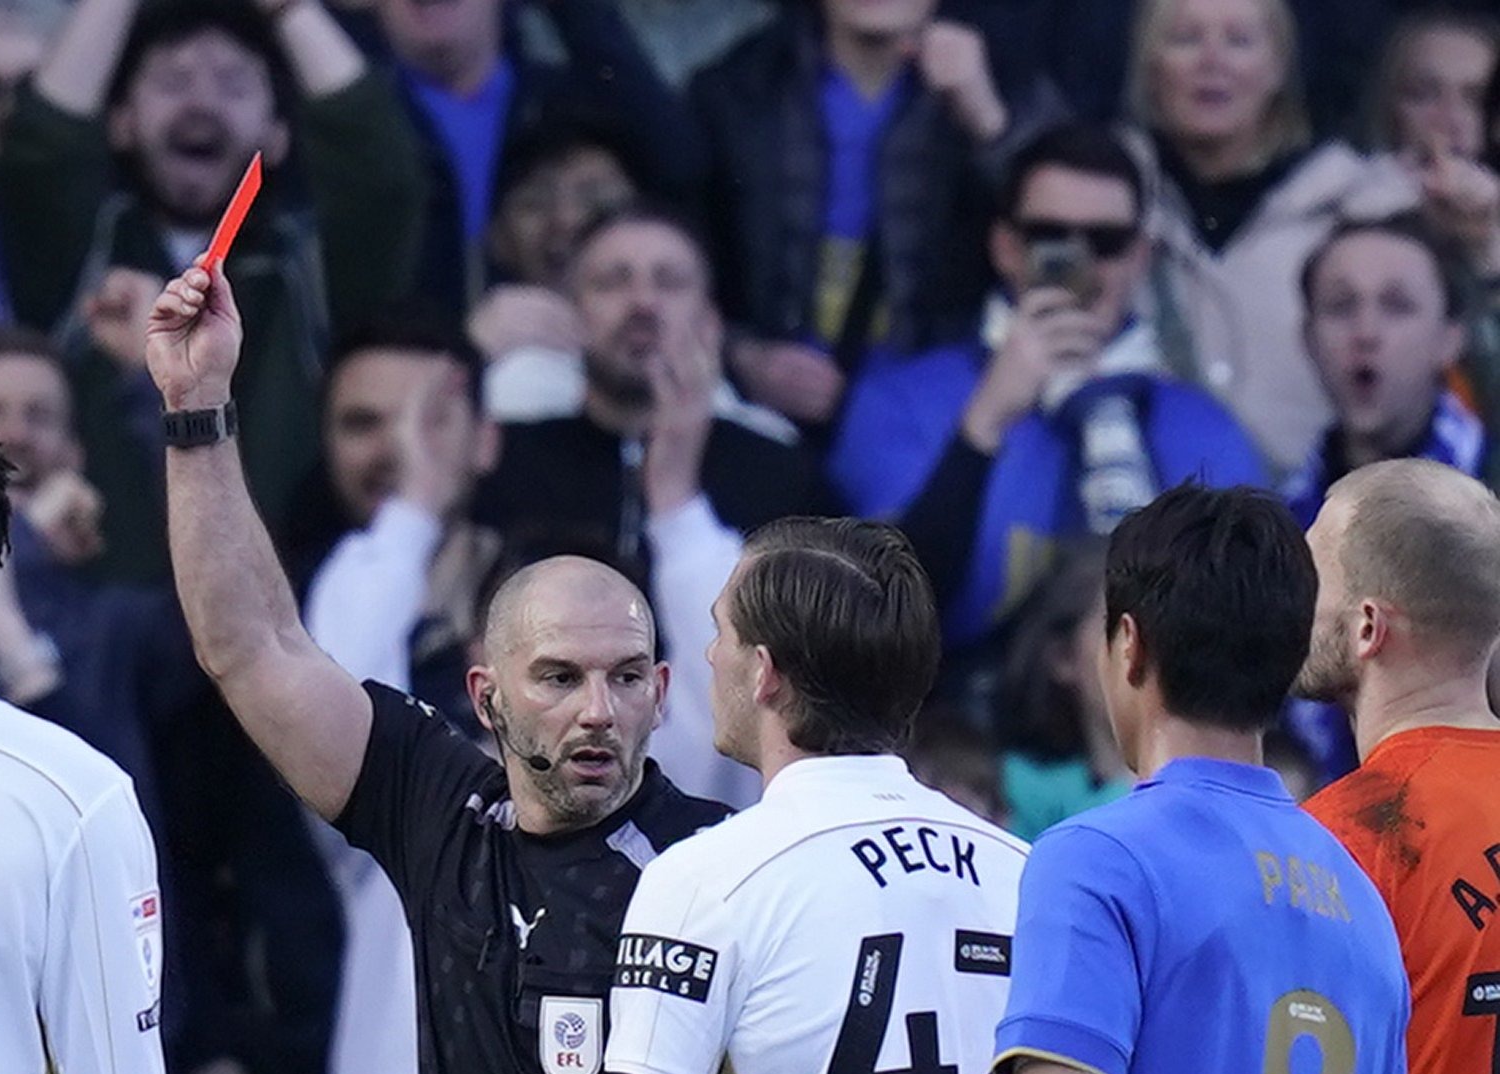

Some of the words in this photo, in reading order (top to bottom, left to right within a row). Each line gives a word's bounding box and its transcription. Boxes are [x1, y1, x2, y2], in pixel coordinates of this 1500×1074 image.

[850, 826, 981, 889] PECK
[616, 937, 715, 981] ILLAGE
[620, 970, 690, 995] OTELS
[556, 1051, 585, 1068] EFL
